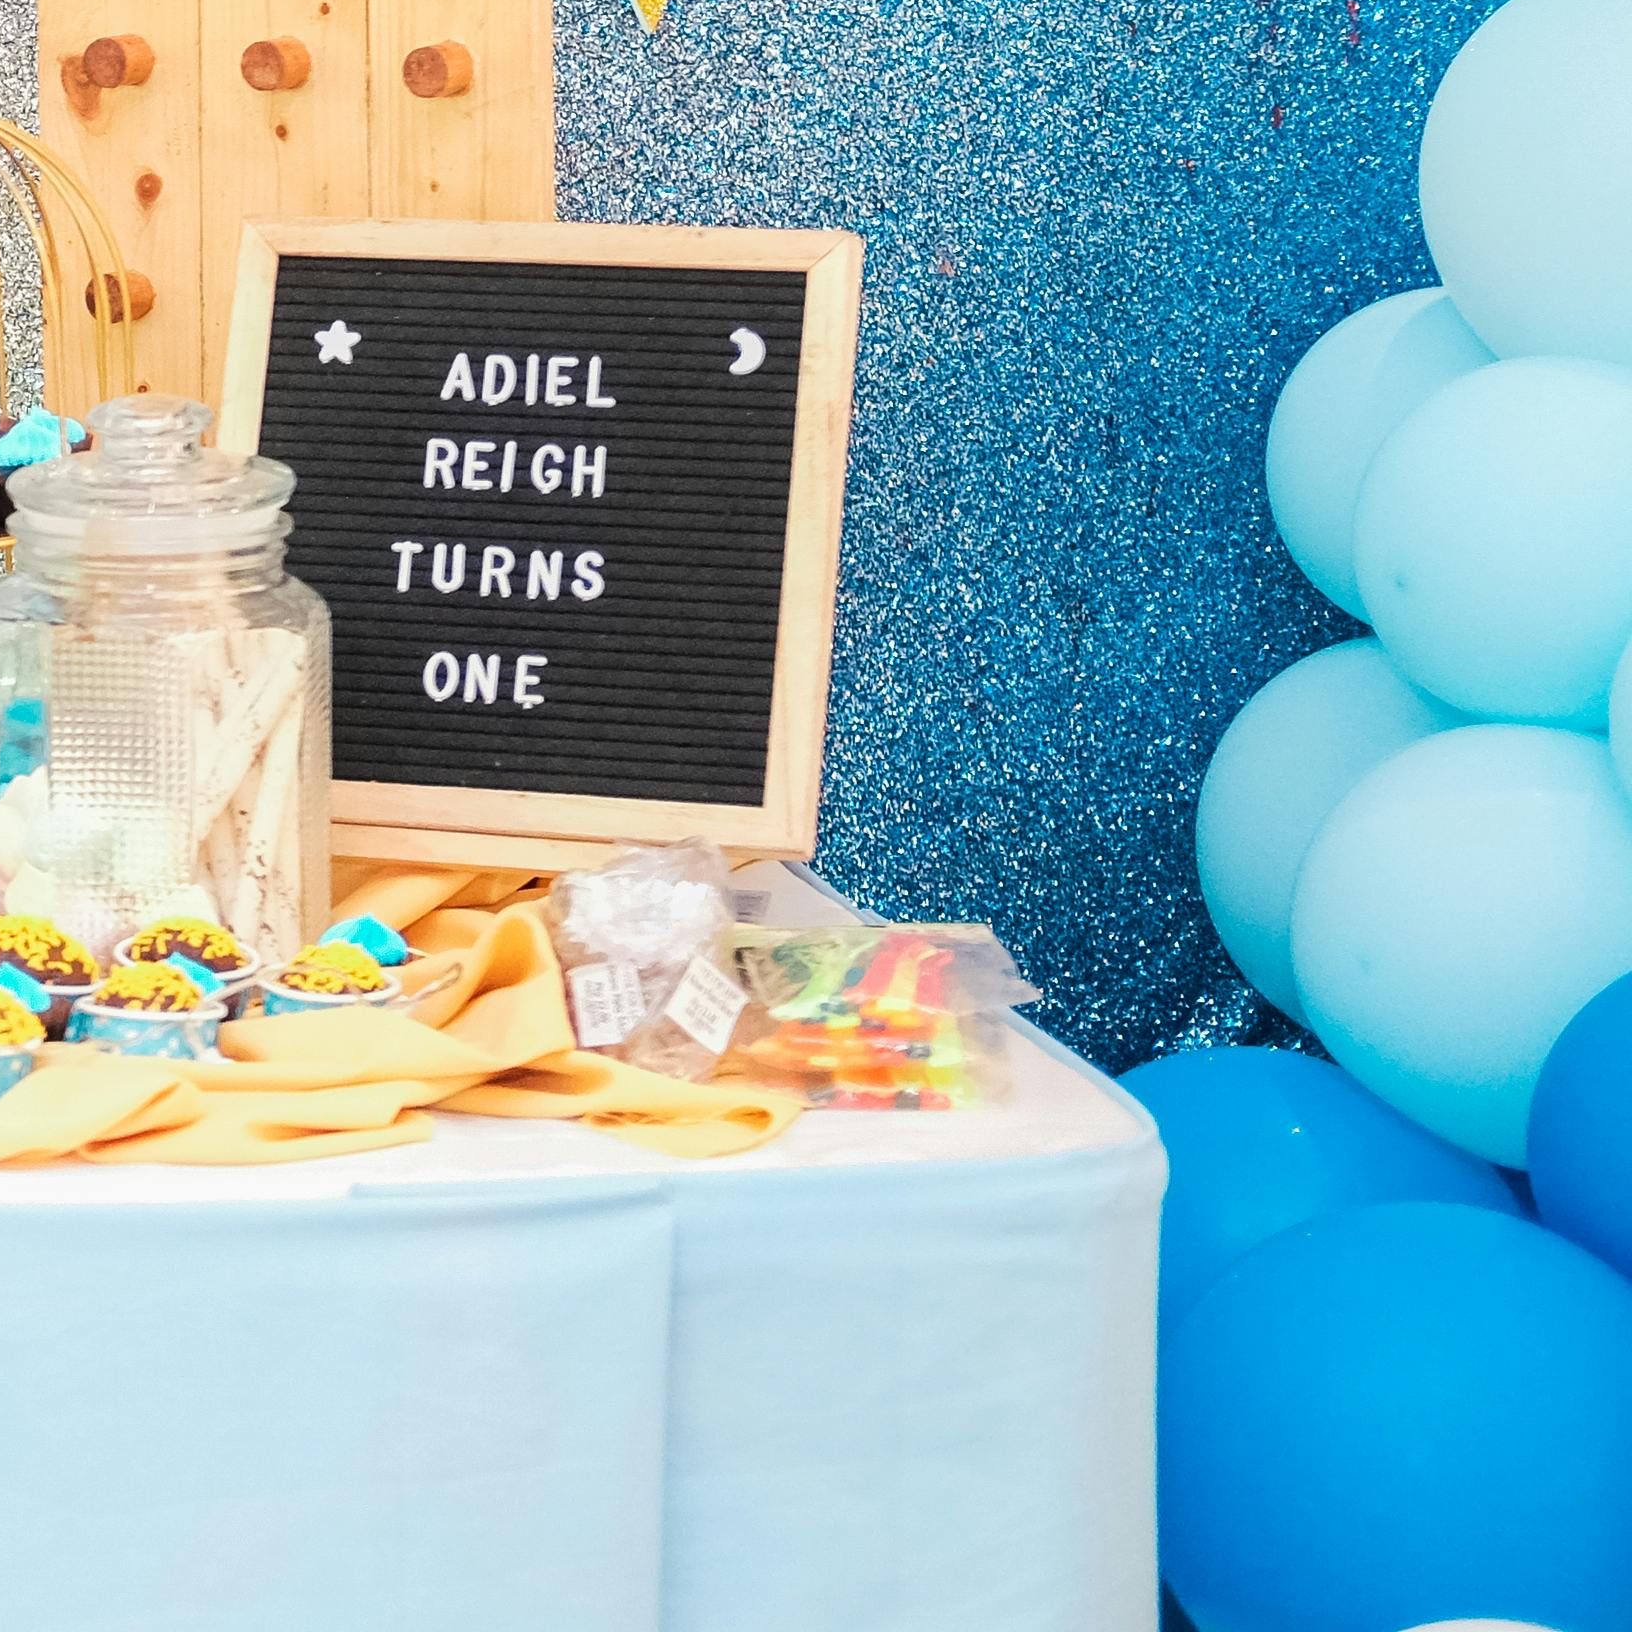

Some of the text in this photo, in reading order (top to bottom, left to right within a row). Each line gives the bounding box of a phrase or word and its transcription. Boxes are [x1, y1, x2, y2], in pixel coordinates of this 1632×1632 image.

[440, 352, 616, 408] ADIEL
[423, 437, 607, 498] REIGH
[391, 540, 605, 601] TURNS
[422, 651, 548, 709] ONE
